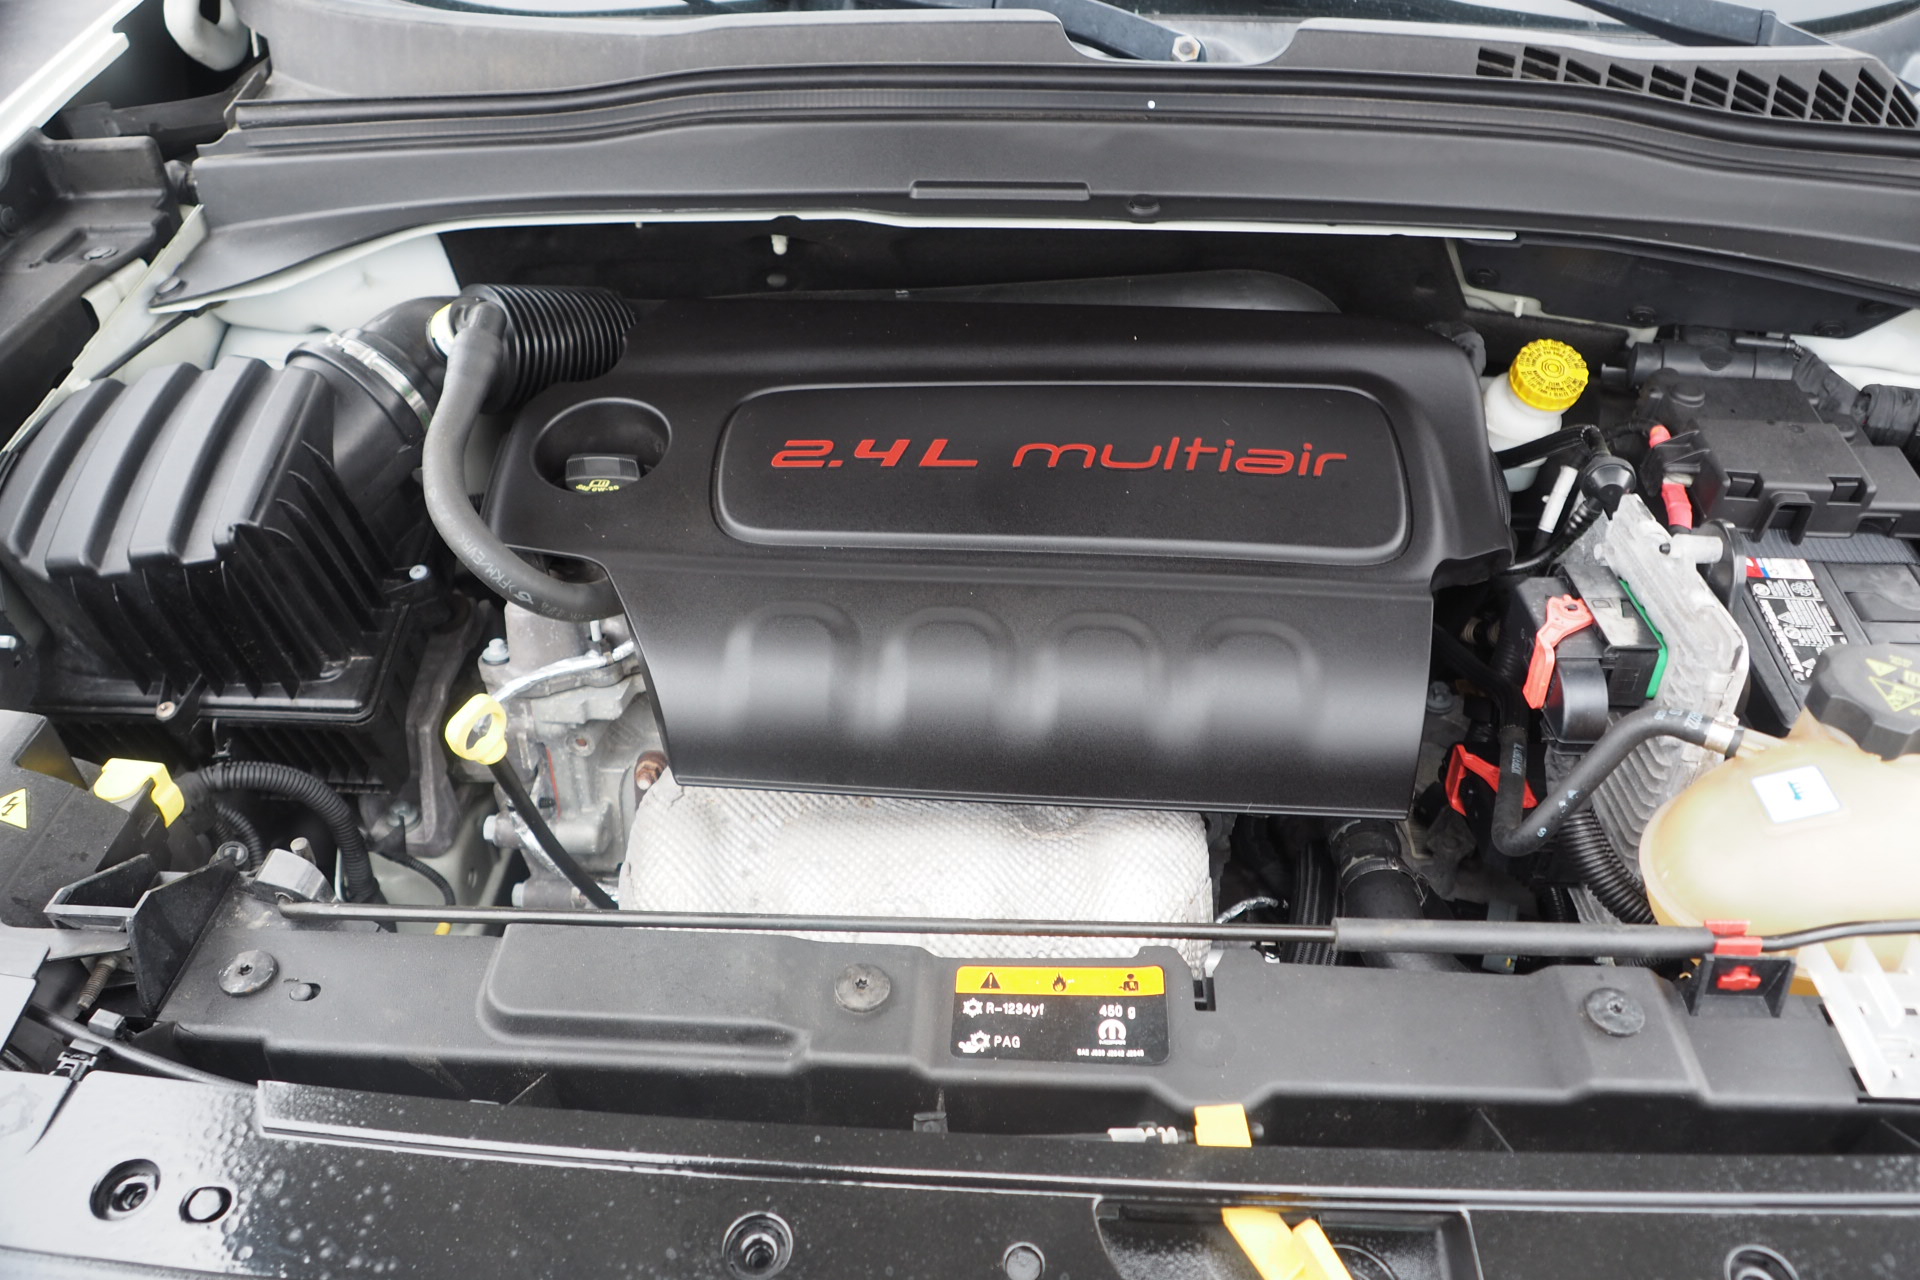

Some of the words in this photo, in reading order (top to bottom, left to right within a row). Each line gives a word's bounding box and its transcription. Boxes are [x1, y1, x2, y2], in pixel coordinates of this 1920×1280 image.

[1013, 437, 1347, 475] multiair
[986, 1002, 1044, 1018] R-1234yf
[1099, 1004, 1123, 1017] 450
[1127, 1006, 1136, 1019] g
[994, 1035, 1020, 1048] PAG
